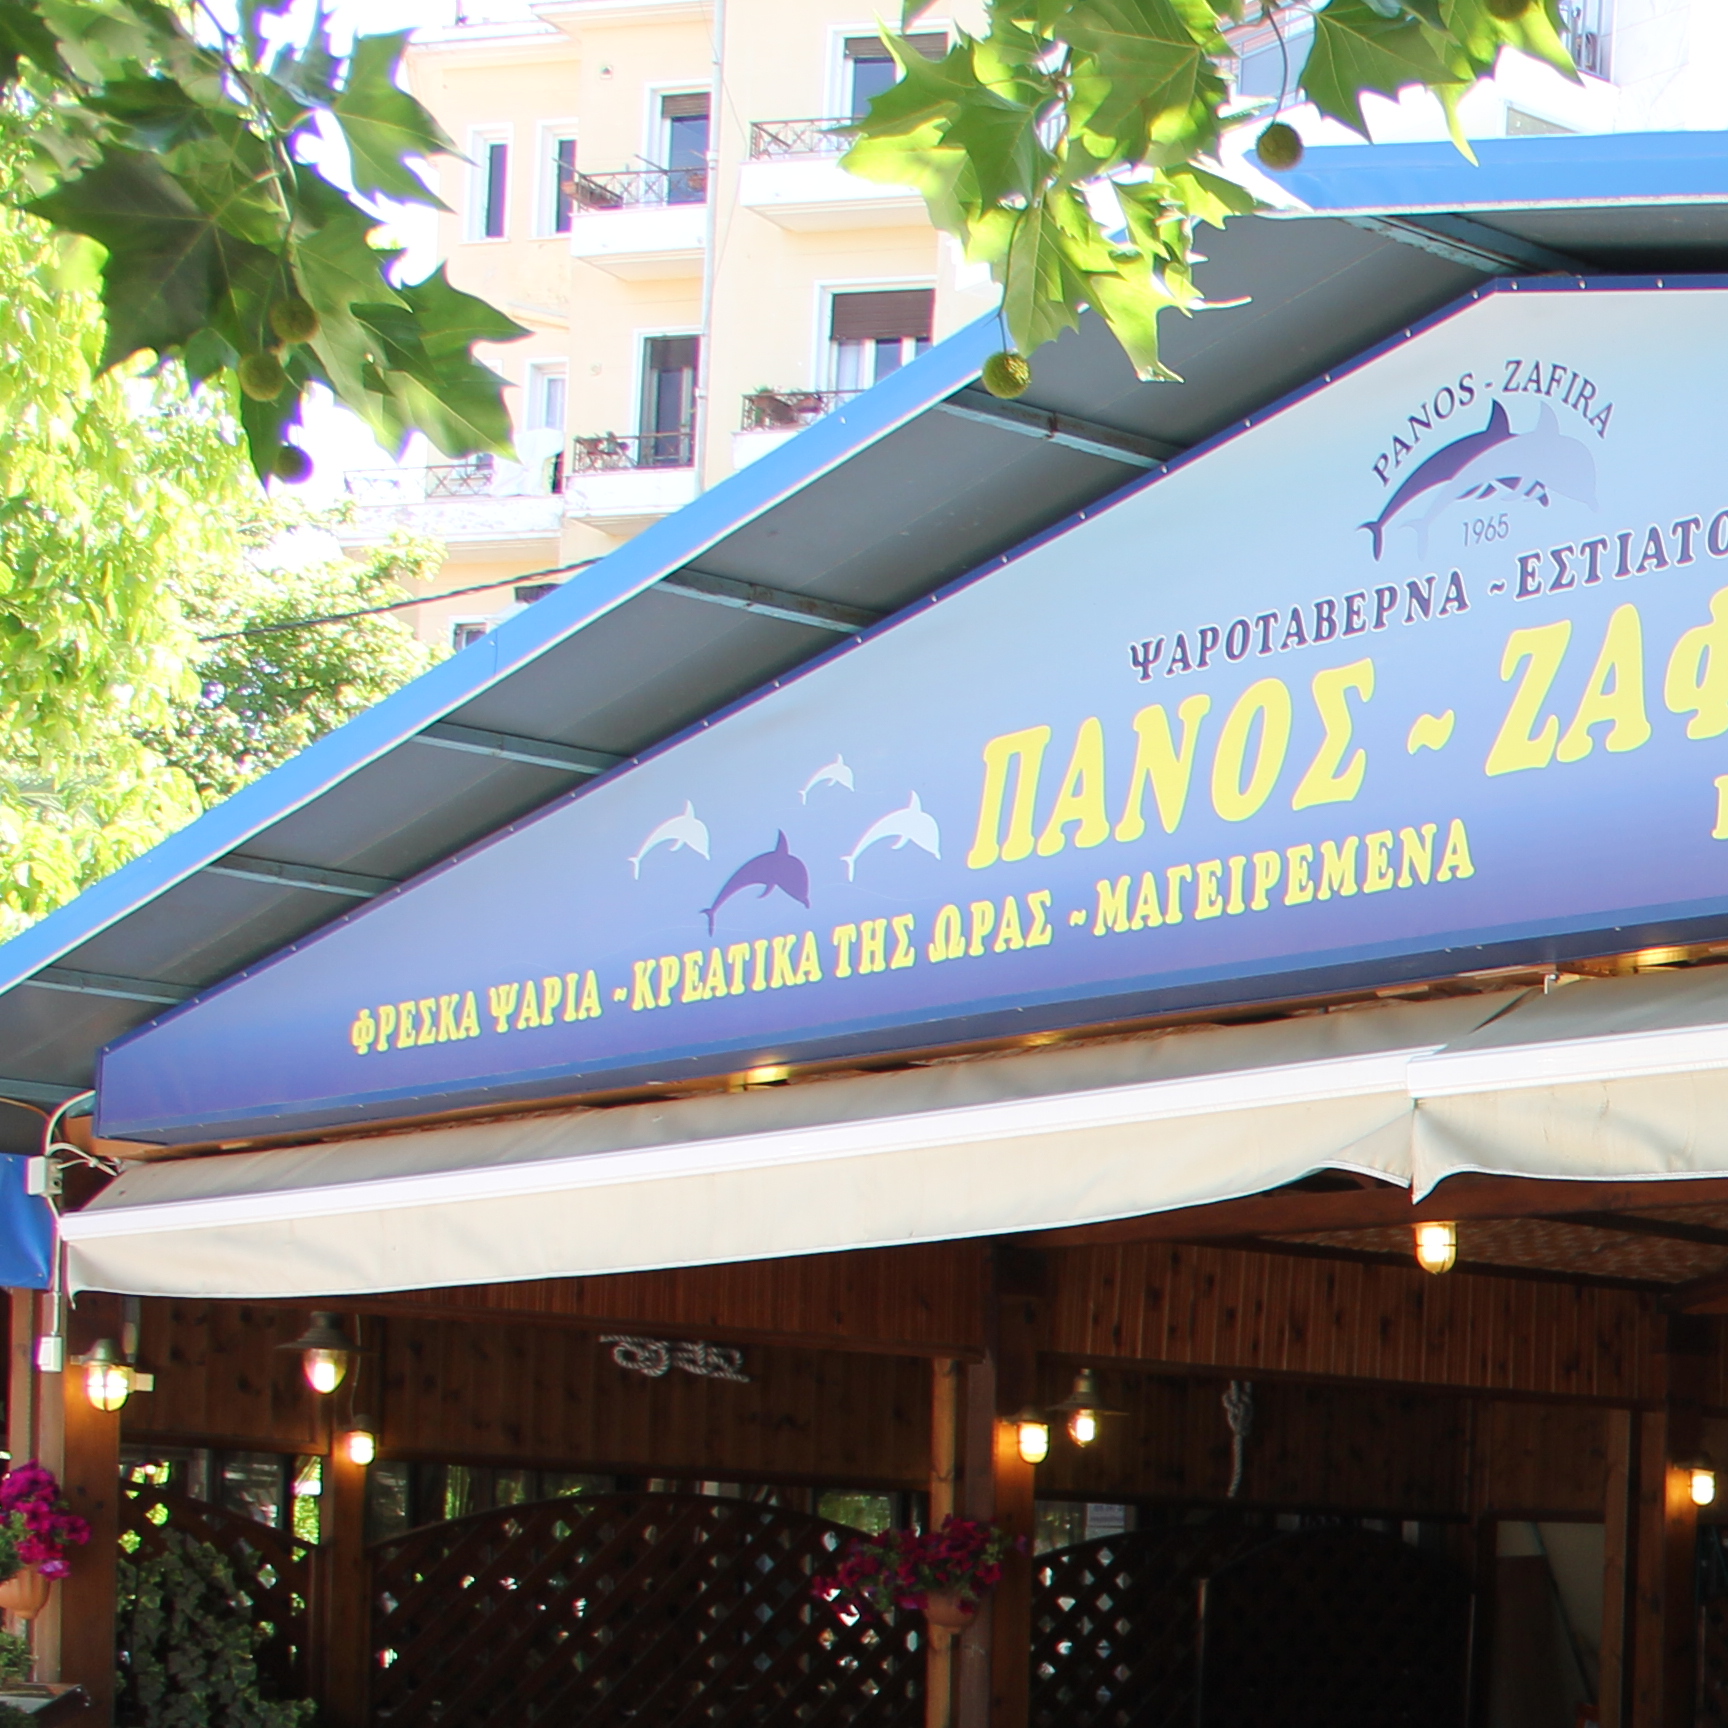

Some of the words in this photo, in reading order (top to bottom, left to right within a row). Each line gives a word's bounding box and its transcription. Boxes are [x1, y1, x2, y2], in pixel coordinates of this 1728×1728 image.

[1373, 372, 1476, 486] PANOS
[1501, 359, 1613, 440] ZAFIRA
[1462, 513, 1509, 547] 1965
[1131, 570, 1469, 681] ΨΑΡΟΤΑΒΕΡΝΑ
[968, 659, 1373, 868] ΠΑΝΟΣ
[352, 993, 478, 1053] ΦΡΕΣΚΑ
[490, 972, 600, 1031] ΨΑΡΙΑ
[834, 915, 913, 976] ΤΗΣ
[929, 891, 1050, 961] ΩΡΑΣ
